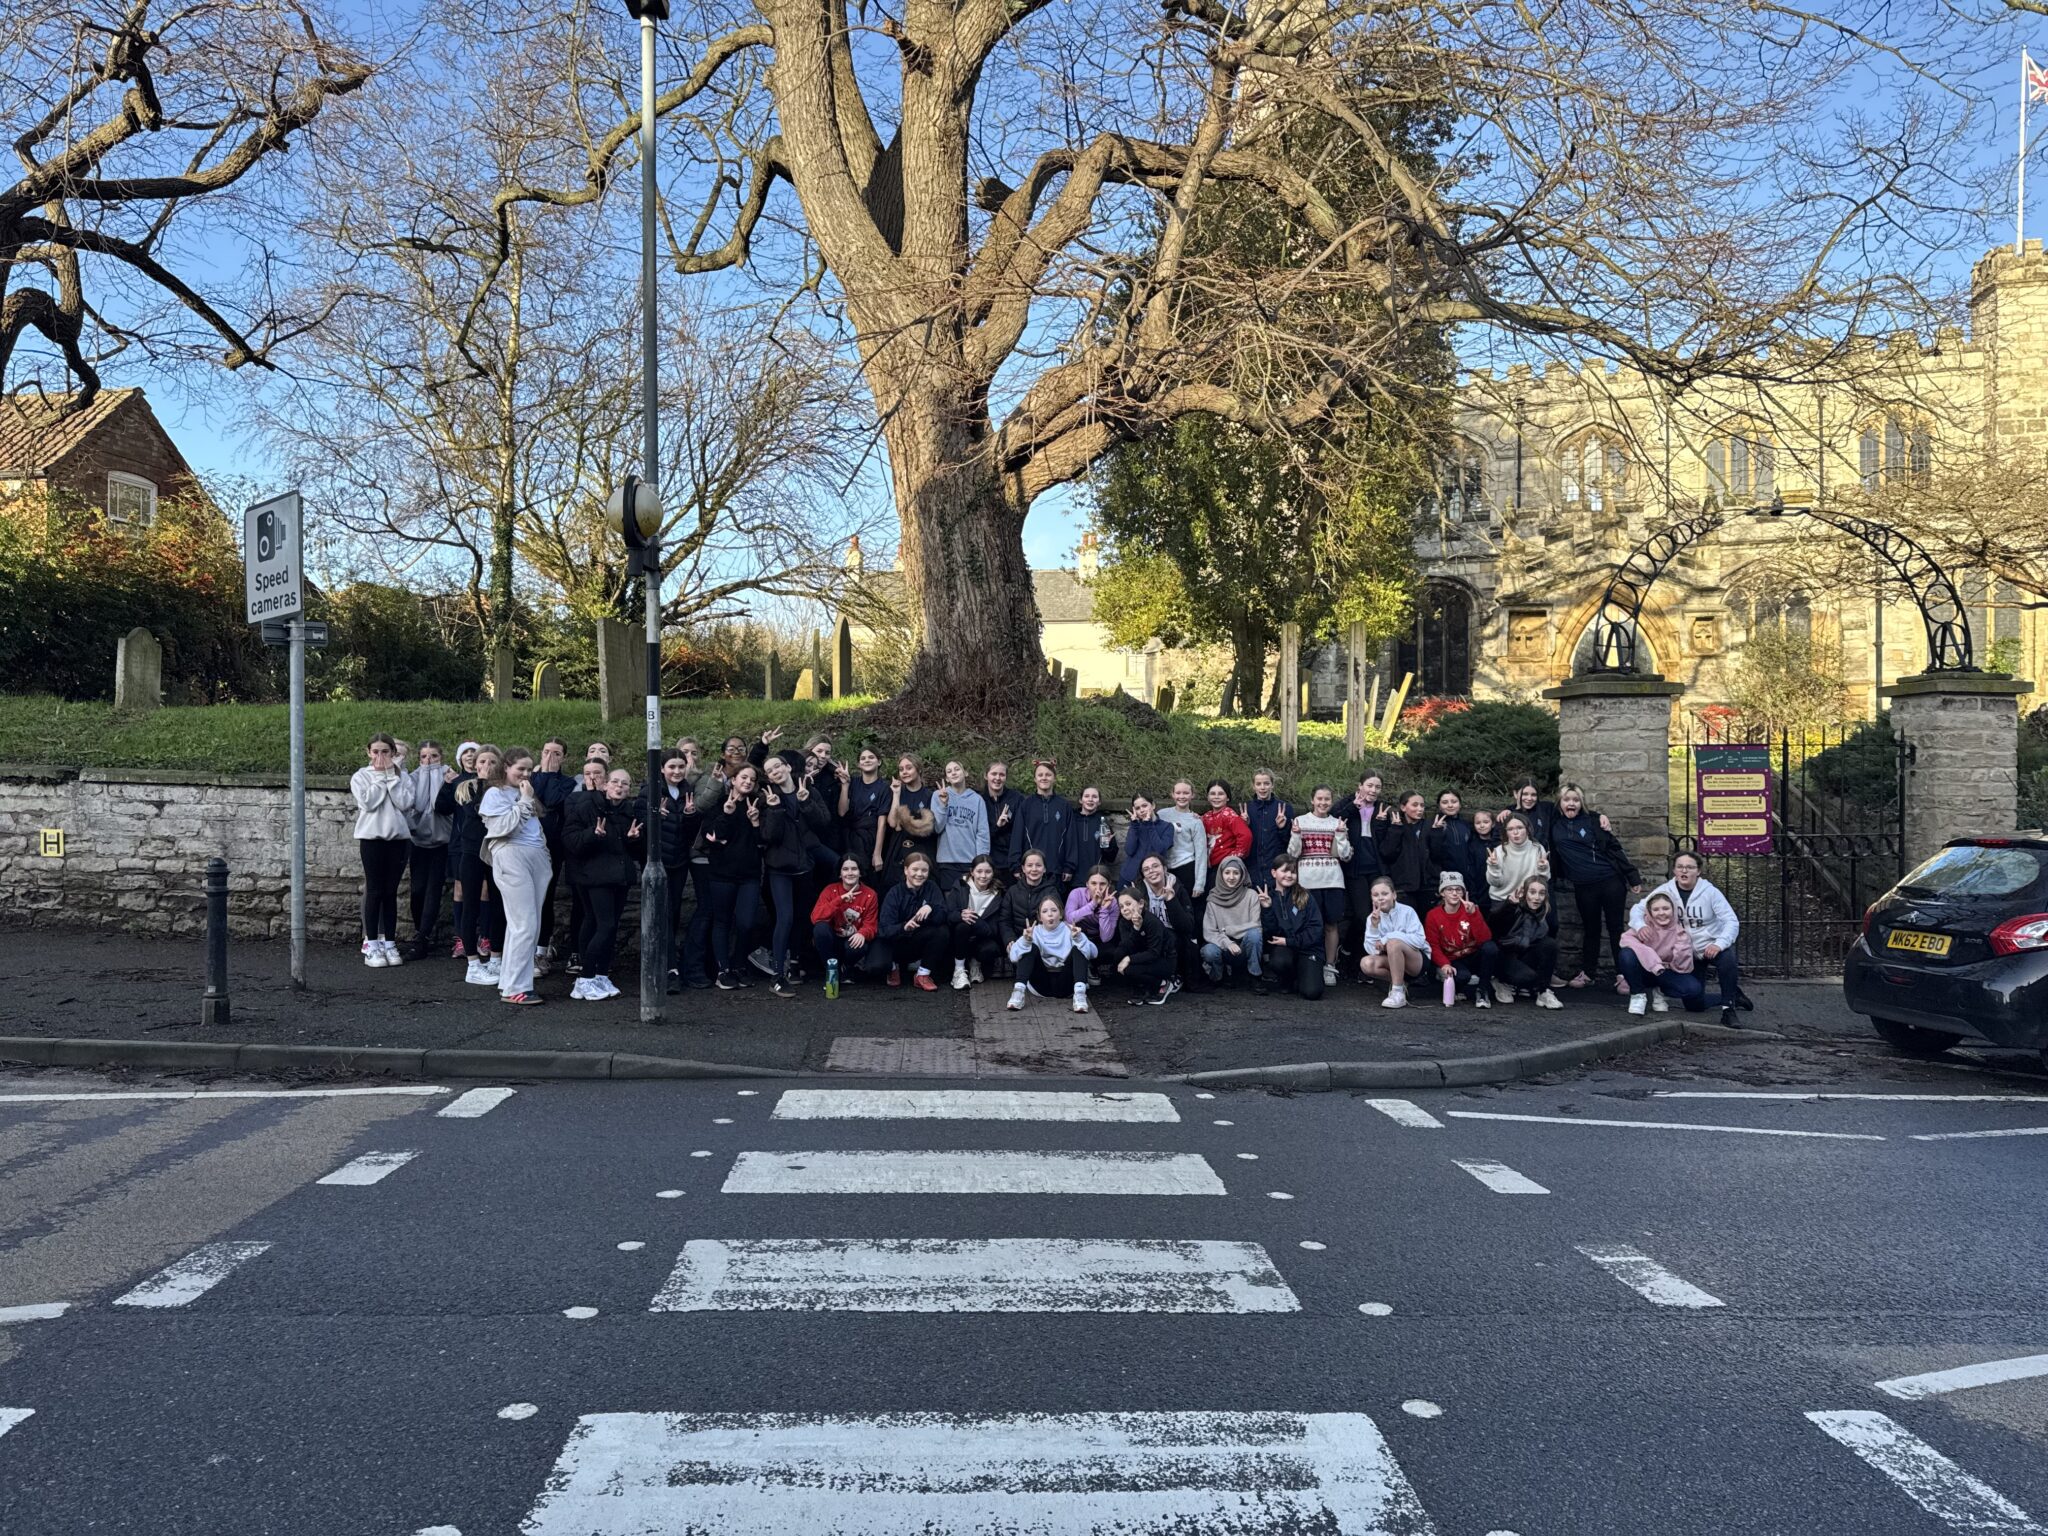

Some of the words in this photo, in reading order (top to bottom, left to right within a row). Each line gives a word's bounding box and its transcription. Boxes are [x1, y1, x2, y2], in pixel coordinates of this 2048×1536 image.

[255, 565, 289, 593] Speed
[251, 591, 297, 616] cameras
[43, 832, 60, 854] H
[1677, 906, 1703, 919] OLLI
[1891, 931, 1919, 948] MK62
